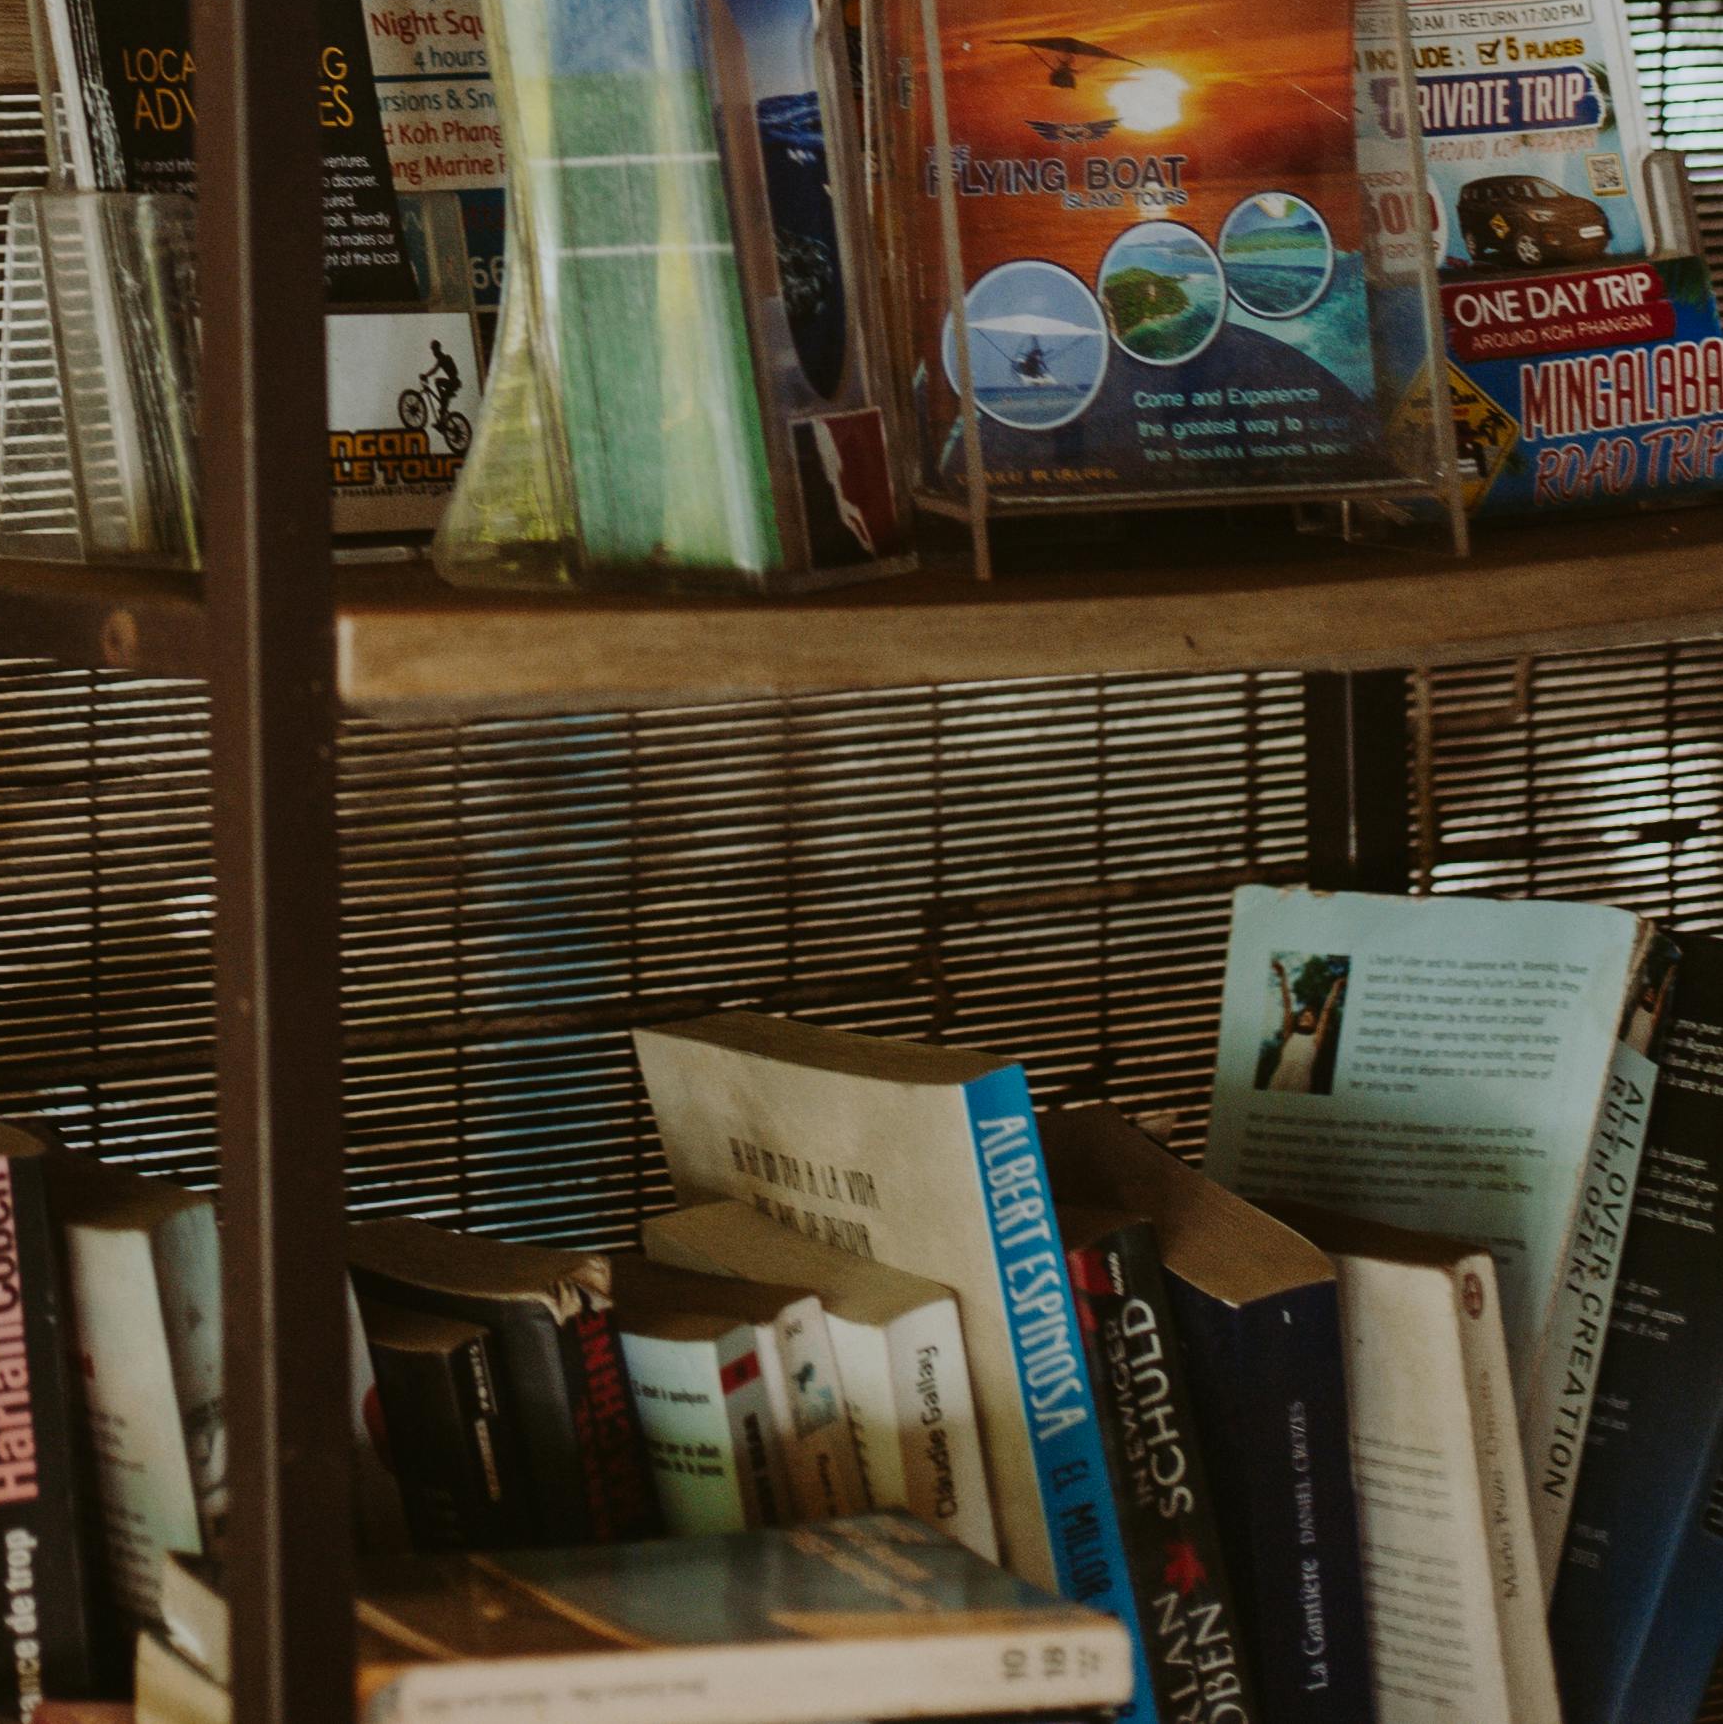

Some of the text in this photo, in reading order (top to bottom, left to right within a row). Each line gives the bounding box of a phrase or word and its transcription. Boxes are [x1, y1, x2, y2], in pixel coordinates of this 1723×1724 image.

[371, 10, 440, 44] Night
[1460, 12, 1518, 29] RETURN
[430, 47, 486, 68] hours
[1364, 38, 1584, 71] INCUDE 5 PLACES
[447, 89, 464, 110] &
[1518, 73, 1586, 122] TRIP
[399, 123, 438, 145] Koh
[427, 155, 494, 177] Marine
[1085, 155, 1187, 191] BOAT
[1454, 272, 1651, 327] ONE DAY TRIP
[1473, 313, 1652, 350] AROUND KOH PHANGAN
[1521, 337, 1723, 441] MINGALABA
[1534, 419, 1723, 507] ROAD TRIP
[1619, 1081, 1645, 1150] ALL
[978, 1115, 1053, 1248] ALBERT
[1566, 1075, 1626, 1296] RUTH OZEKI
[1588, 1171, 1627, 1281] OVER
[1004, 1252, 1088, 1442] ESPINOSA
[1122, 1297, 1194, 1520] SCHULD
[1543, 1292, 1603, 1498] CREATION
[4, 1525, 39, 1591] trop
[5, 1596, 38, 1635] de
[1305, 1662, 1329, 1692] La
